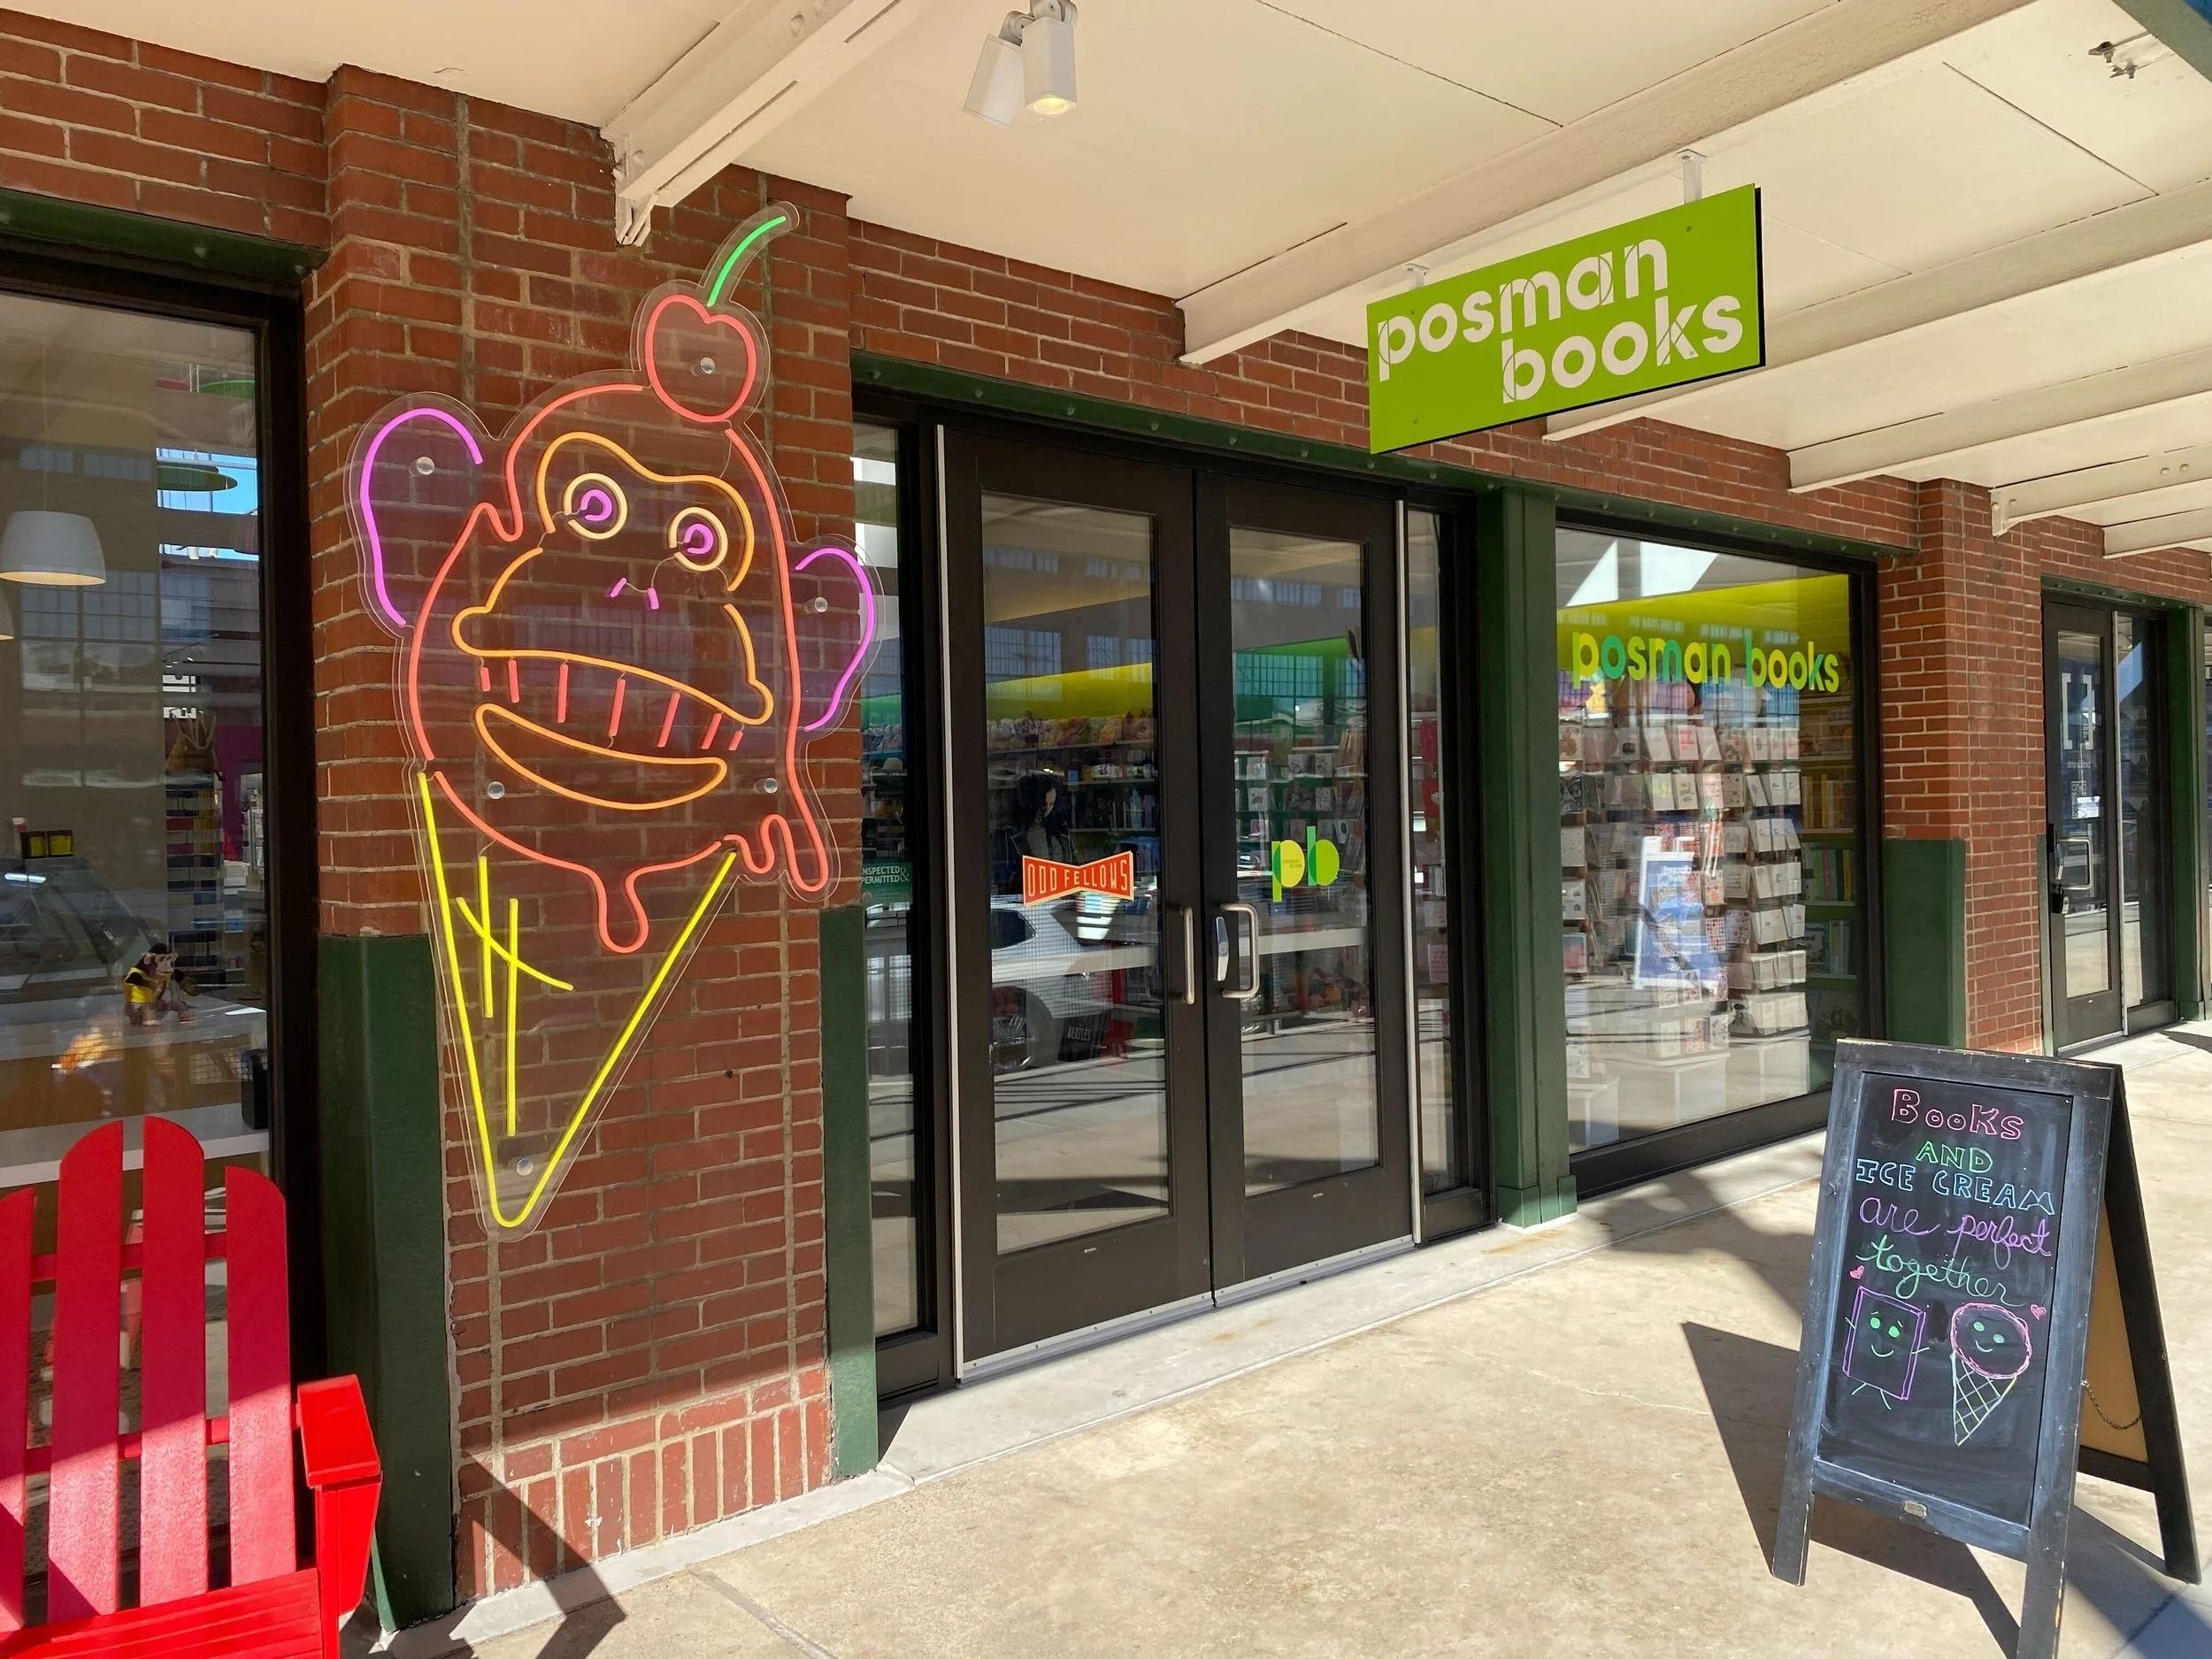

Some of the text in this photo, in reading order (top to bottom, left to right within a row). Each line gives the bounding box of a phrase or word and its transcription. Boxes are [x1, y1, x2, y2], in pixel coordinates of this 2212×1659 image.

[1378, 239, 1668, 382] posman
[1502, 295, 1743, 403] books
[1572, 631, 1839, 693] posman books
[862, 866, 900, 876] NSPECTED
[1271, 826, 1340, 902] pb
[1855, 1159, 2055, 1215] ICE CREAM
[1916, 1141, 1993, 1173] AND
[1859, 1196, 2052, 1271] are perfect
[1855, 1234, 2025, 1306] together
